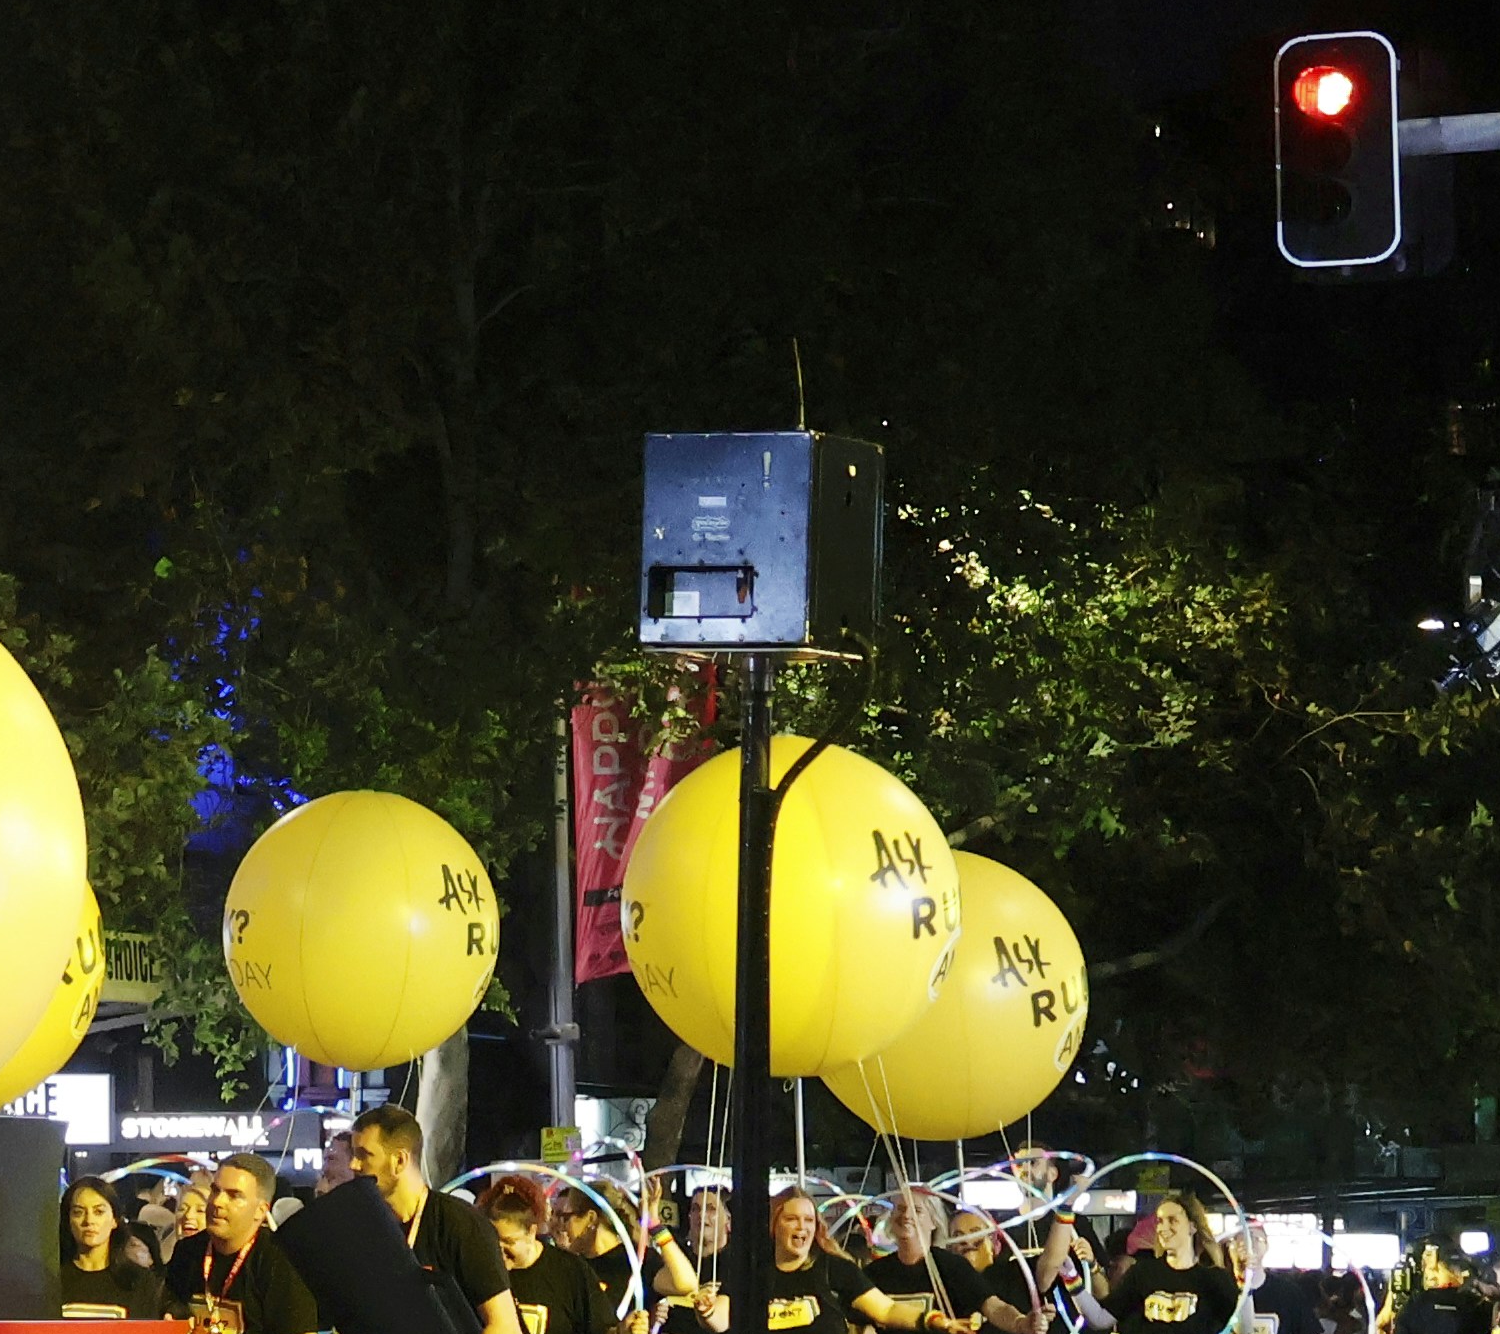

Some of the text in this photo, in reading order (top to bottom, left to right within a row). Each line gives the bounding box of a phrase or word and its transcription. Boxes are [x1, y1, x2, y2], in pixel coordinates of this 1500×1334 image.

[870, 829, 933, 887] Ask
[438, 864, 484, 914] Ask
[992, 935, 1050, 987] Ask
